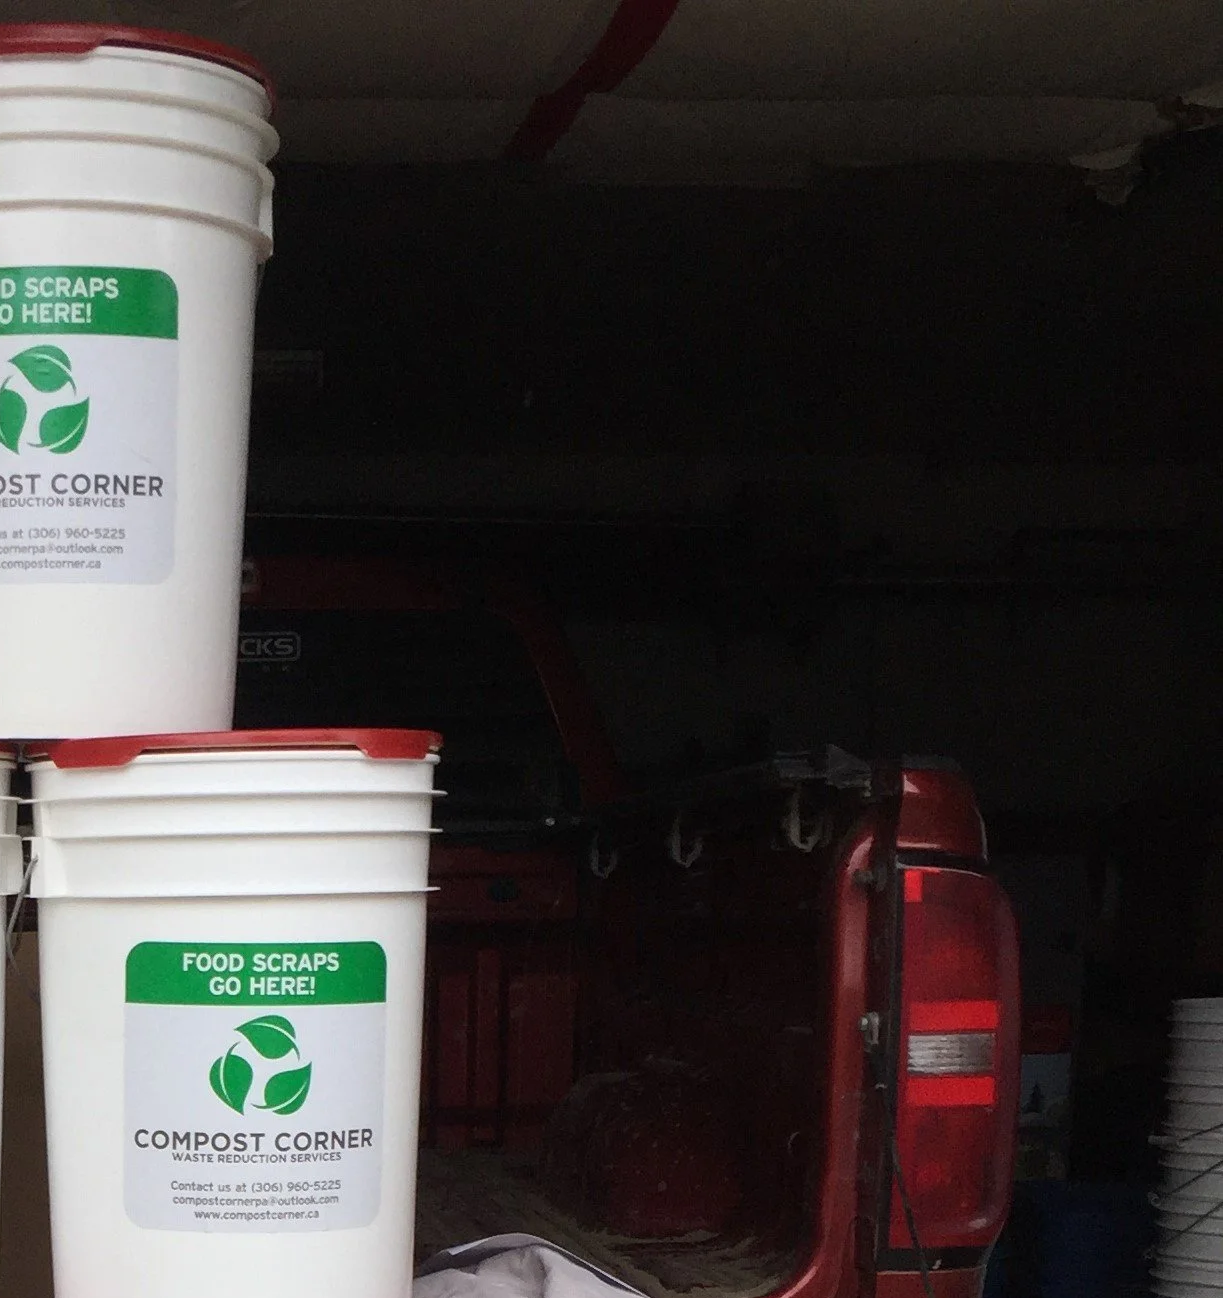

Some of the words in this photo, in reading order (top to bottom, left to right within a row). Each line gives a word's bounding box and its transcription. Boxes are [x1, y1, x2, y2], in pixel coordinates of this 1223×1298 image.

[24, 278, 119, 299] SCRAPS
[22, 302, 92, 323] HERE!
[51, 474, 164, 497] CORNER
[68, 497, 125, 508] SERVICES
[12, 529, 23, 539] at
[28, 528, 60, 539] (306)
[65, 528, 125, 539] 960-5225
[183, 953, 244, 972] FOOD
[253, 953, 339, 972] SCRAPS
[210, 977, 241, 995] GO
[250, 977, 315, 995] HERE!
[134, 1129, 265, 1152] COMPOST
[275, 1129, 373, 1152] CORNER
[172, 1153, 214, 1163] WASTE
[218, 1154, 286, 1163] REDUCTION
[291, 1152, 341, 1163] SERVICES
[171, 1181, 213, 1192] Contact
[218, 1184, 231, 1192] us
[236, 1183, 246, 1193] at
[251, 1182, 283, 1193] (306)
[287, 1180, 341, 1192] 960-5225
[195, 1210, 319, 1221] www.compostcorner.ca
